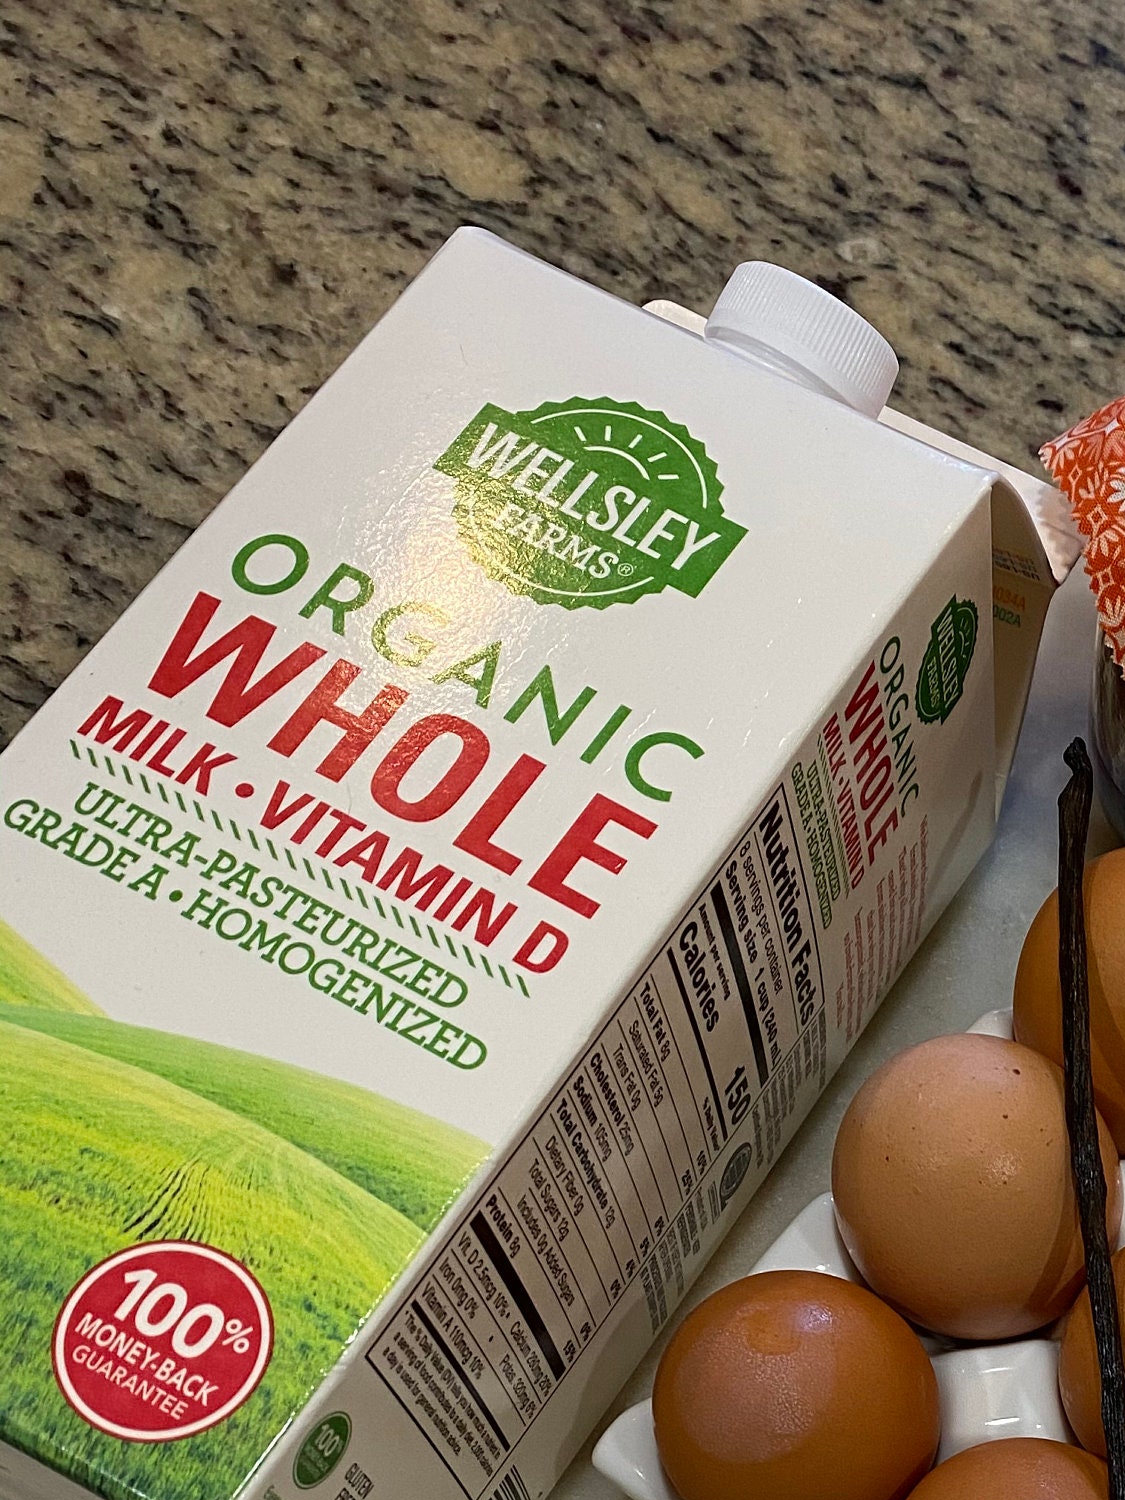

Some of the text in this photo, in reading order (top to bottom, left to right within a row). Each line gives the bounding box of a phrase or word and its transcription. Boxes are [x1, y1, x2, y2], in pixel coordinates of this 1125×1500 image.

[464, 422, 719, 571] WELLSLEY
[231, 534, 705, 802] ORGANIC
[936, 605, 958, 713] WELLSLEY
[148, 592, 658, 919] WHOLE
[844, 661, 898, 866] WHOLE
[880, 636, 919, 818] ORGANIC
[76, 696, 570, 975] MILK VITAMIN D
[791, 762, 810, 818] GRADE
[806, 828, 832, 930] HOMOGENIZED
[806, 760, 841, 908] ULTRA-PASTEURIZED
[822, 712, 846, 781] MILK
[837, 779, 862, 875] VITAMIN
[851, 865, 864, 890] D
[3, 799, 488, 1071] GRADE A HOMOGENIZED
[73, 784, 470, 1009] ULTRA-PASTEURIZED
[725, 860, 749, 932] Serving
[740, 840, 783, 995] 8 servings per container
[759, 800, 802, 953] Nutrition
[791, 939, 816, 1026] Facts
[698, 902, 730, 1001] Amount per serving
[744, 928, 758, 964] size
[754, 967, 764, 982] 1
[640, 981, 659, 1023] Total
[652, 1016, 666, 1045] Fat
[660, 1040, 670, 1062] 8g
[679, 921, 719, 1032] Calories
[724, 1066, 751, 1125] 150
[757, 981, 769, 1012] cup
[761, 1006, 778, 1043] (240
[590, 1052, 625, 1126] Cholesterol
[618, 1121, 634, 1156] 25mg
[612, 1042, 641, 1112] Trans Fat 0g
[628, 1020, 654, 1075] Saturated
[647, 1068, 660, 1093] Fat
[654, 1086, 663, 1108] 5g
[556, 1097, 577, 1137] Total
[572, 1132, 608, 1210] Carbohydrate
[605, 1206, 615, 1229] 12g
[573, 1075, 597, 1127] Sodium
[594, 1122, 612, 1162] 105mg
[528, 1158, 569, 1242] Total Sugars 12g
[545, 1135, 567, 1178] Dietary
[562, 1170, 578, 1200] Fiber
[574, 1195, 584, 1216] 0g
[439, 1256, 455, 1284] Iron
[485, 1194, 513, 1243] Protein
[509, 1236, 520, 1259] 8g
[517, 1194, 541, 1240] Includes
[543, 1246, 563, 1279] Added
[114, 1269, 253, 1359] 100%
[422, 1281, 447, 1324] Vitamin
[442, 1317, 454, 1332] A
[467, 1249, 479, 1265] D
[510, 1321, 531, 1358] Calcium
[72, 1345, 189, 1421] GUARANTEE
[75, 1313, 219, 1407] MONEY-BACK
[344, 1462, 374, 1499] GLUTEN
